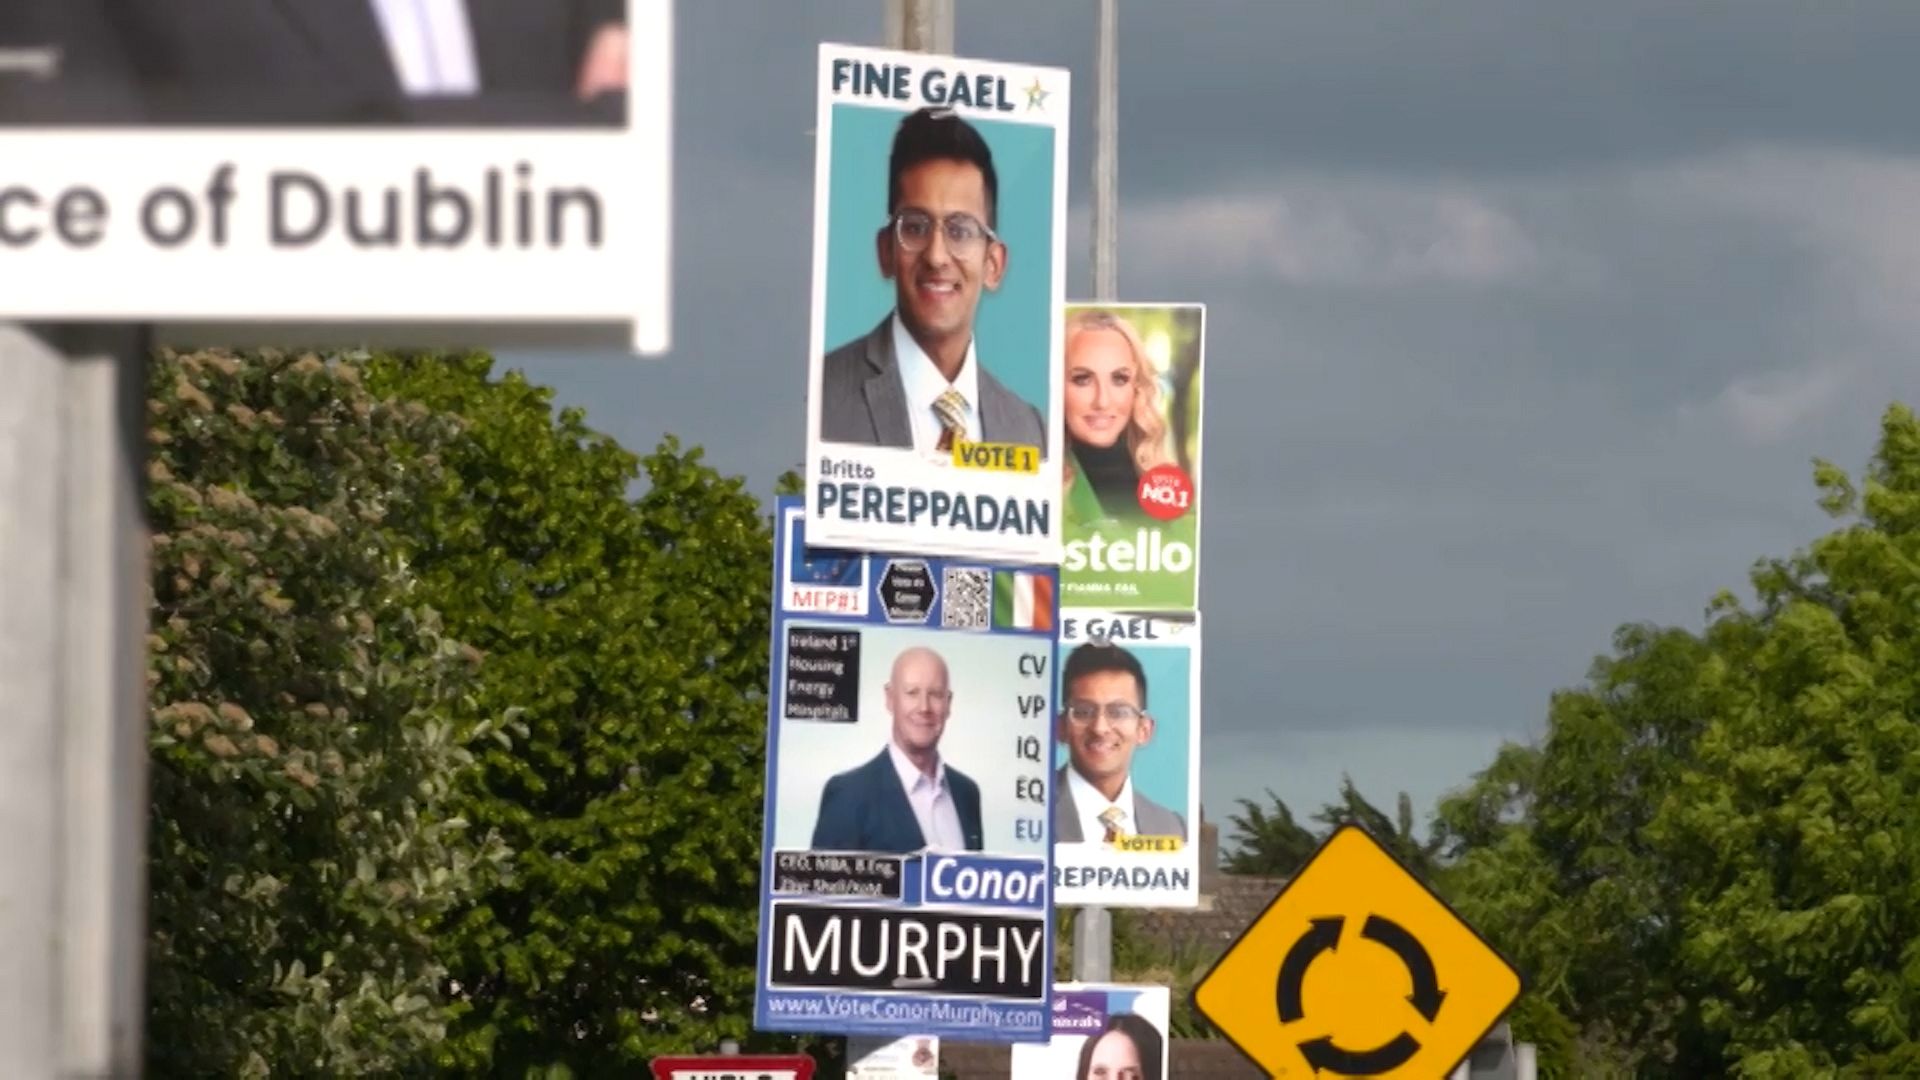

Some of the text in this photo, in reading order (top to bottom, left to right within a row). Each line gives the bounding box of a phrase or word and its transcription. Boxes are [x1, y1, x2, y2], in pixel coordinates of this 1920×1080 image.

[832, 58, 1015, 111] FINE GAEL
[139, 162, 237, 249] of
[267, 162, 604, 249] Dublin
[820, 457, 875, 480] Britto
[960, 444, 1033, 470] VOTE 1
[817, 480, 1050, 537] PEREPPADAN
[1060, 527, 1193, 574] stello
[1085, 617, 1159, 641] GAEL
[790, 657, 844, 676] Housing
[1018, 653, 1047, 677] CV
[789, 679, 835, 699] Energy
[1018, 695, 1046, 718] VP
[1016, 736, 1042, 762] IQ
[1015, 777, 1045, 803] EQ
[1015, 820, 1043, 842] EU
[1121, 839, 1177, 851] VOTE 1
[932, 858, 1046, 904] Conor
[783, 914, 1042, 986] MURPHY
[767, 995, 1042, 1027] www.VoteConorMurphy.com
